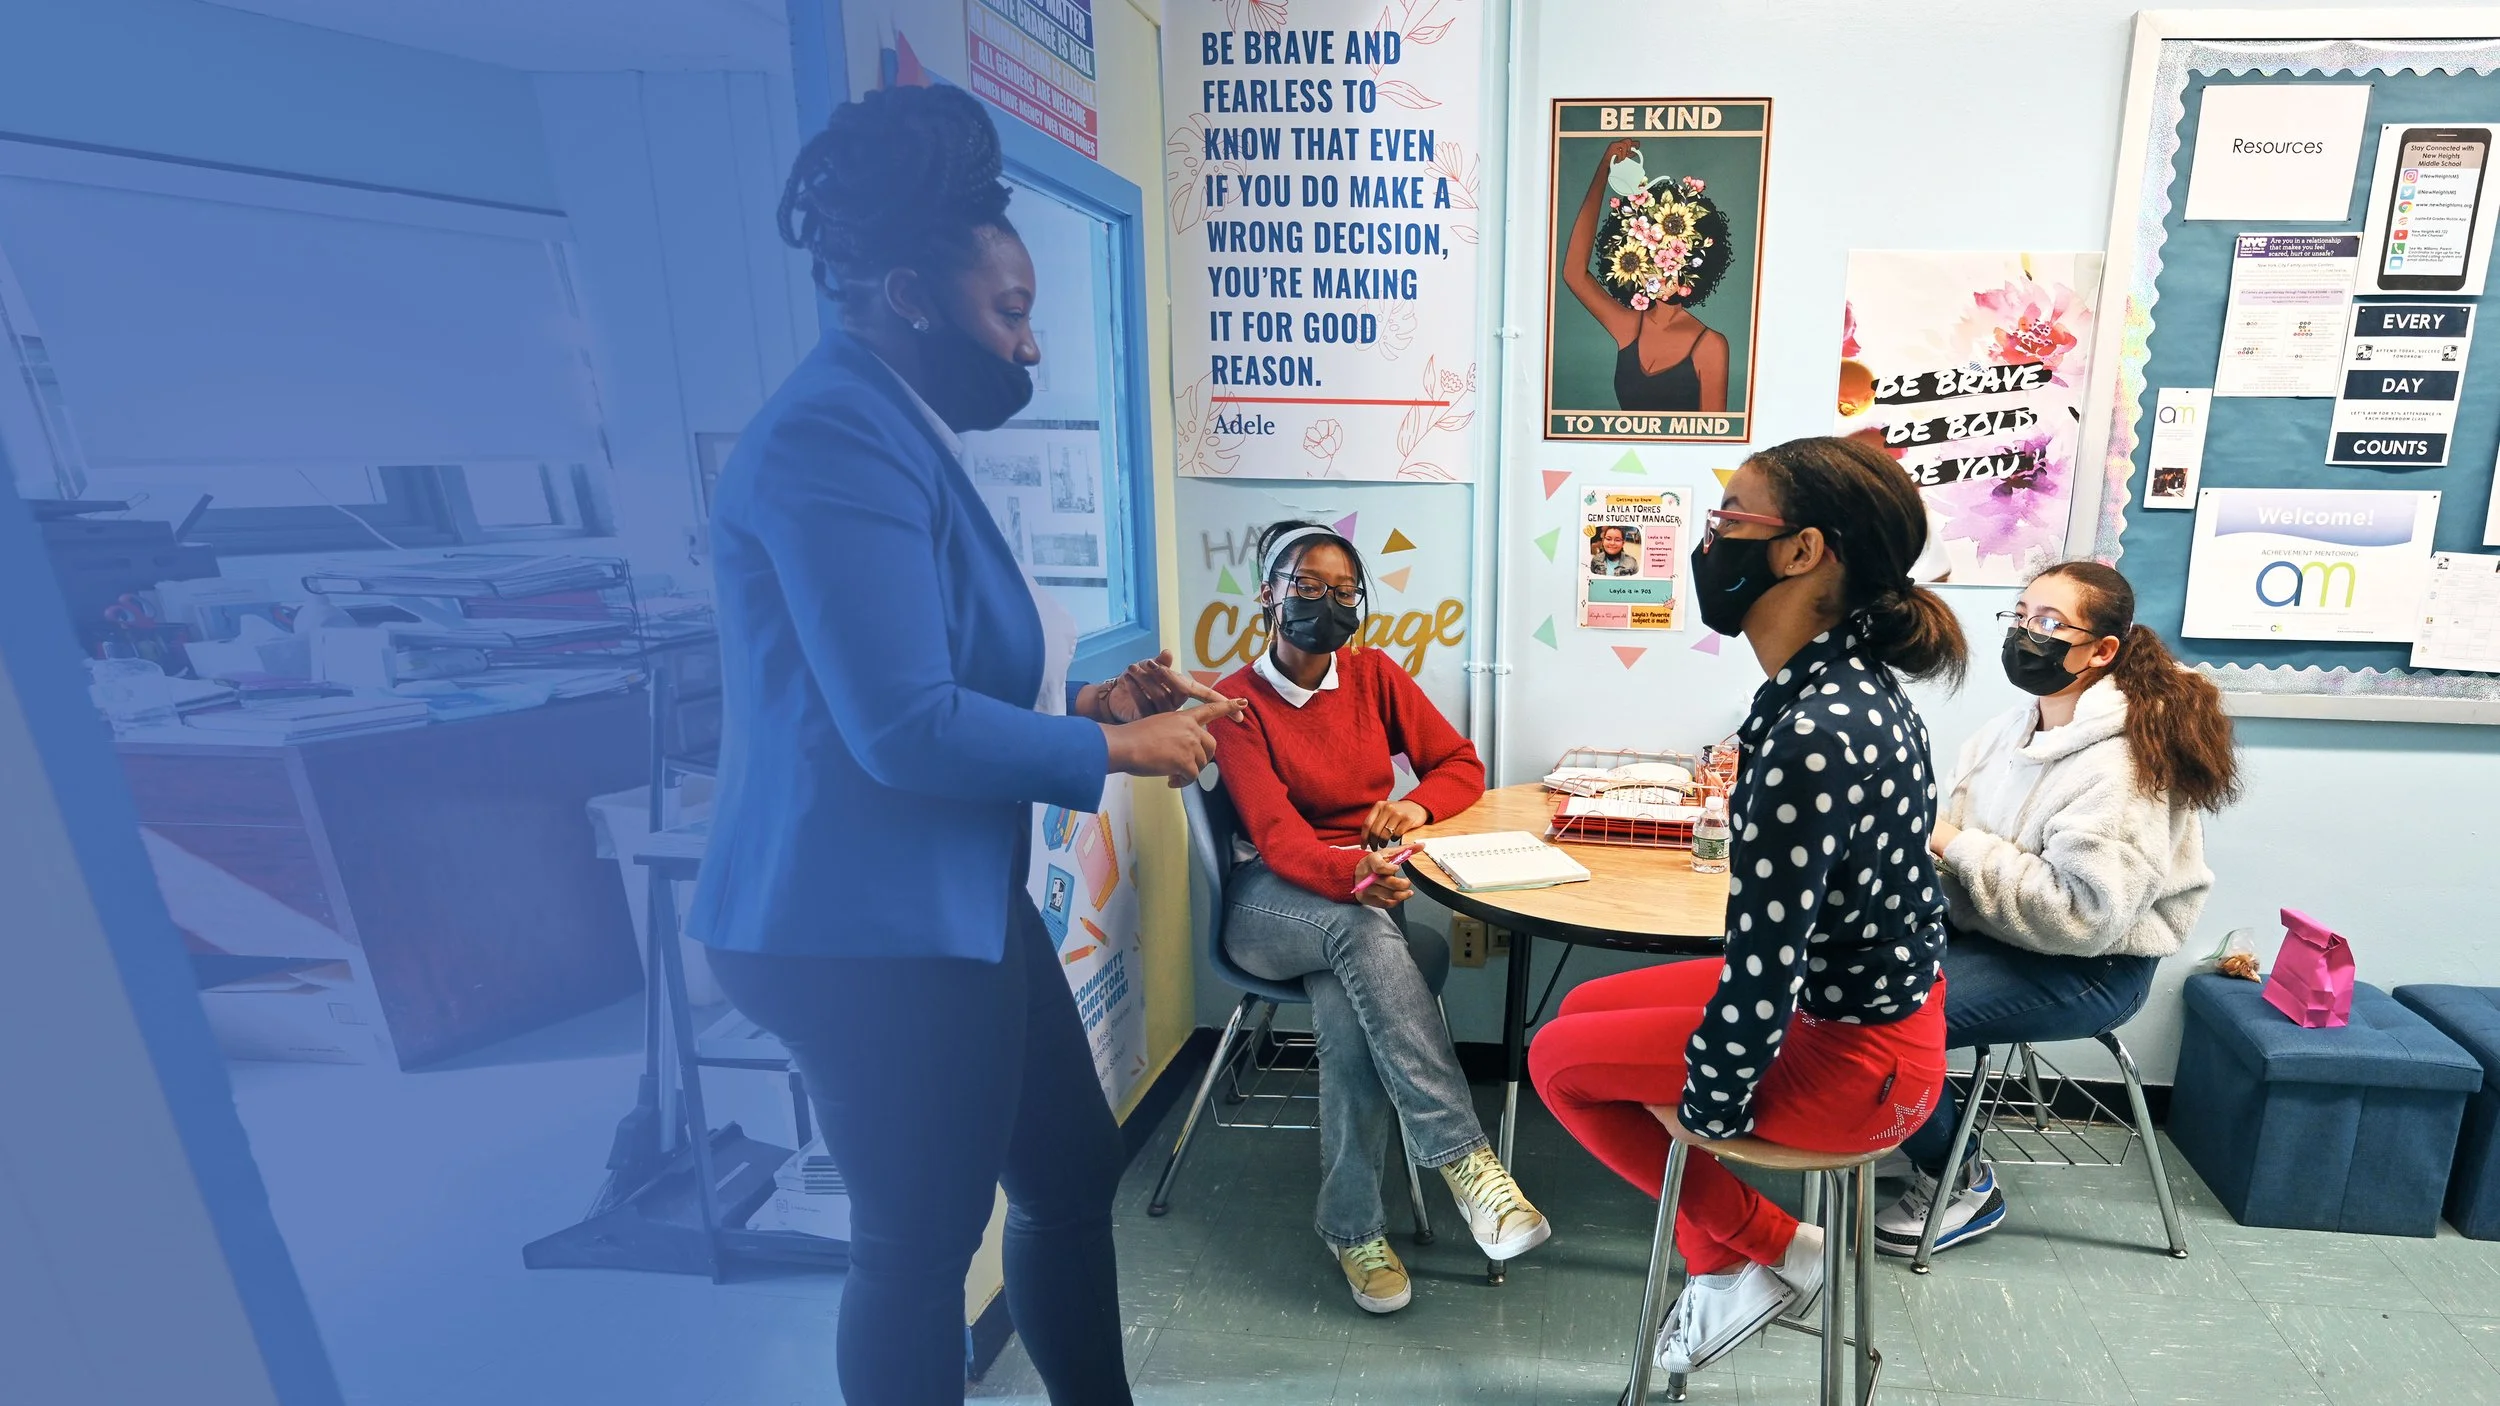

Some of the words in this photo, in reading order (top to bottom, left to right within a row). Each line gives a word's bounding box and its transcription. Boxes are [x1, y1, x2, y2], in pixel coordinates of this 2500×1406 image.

[1017, 0, 1057, 53] CHANGE
[1058, 31, 1068, 60] IS
[1070, 38, 1093, 76] REAL
[1202, 32, 1233, 65] BE
[1245, 31, 1334, 65] BRAVE
[1345, 31, 1400, 65] AND
[978, 40, 995, 71] ALL
[996, 52, 1035, 95] GENDERS
[1036, 78, 1051, 106] ARE
[1051, 87, 1087, 129] WELCOME
[1204, 80, 1333, 113] FEARLESS
[1343, 80, 1376, 113] TO
[972, 70, 1000, 102] WOMEN
[1000, 87, 1019, 112] HAVE
[1019, 99, 1044, 127] AGENCY
[1044, 113, 1058, 137] OVER
[1058, 123, 1075, 145] THEIR
[1600, 107, 1635, 130] BE
[1645, 106, 1722, 130] KIND
[1205, 127, 1280, 161] KNOW
[1292, 128, 1359, 160] THAT
[1371, 129, 1434, 162] EVEN
[2233, 138, 2323, 155] Resources
[2425, 144, 2461, 152] Connected
[1206, 175, 1234, 207] IF
[1237, 175, 1290, 207] YOU
[1303, 175, 1338, 208] DO
[1350, 176, 1423, 208] MAKE
[1434, 177, 1450, 209] A
[1207, 221, 1302, 253] WRONG
[1315, 222, 1449, 260] DECISION,
[2240, 237, 2268, 247] NYC
[2306, 237, 2342, 245] relationship
[1208, 266, 1302, 299] YOU'RE
[1313, 268, 1417, 300] MAKING
[1210, 311, 1233, 342] IT
[1243, 311, 1294, 343] FOR
[1304, 312, 1377, 344] GOOD
[2382, 313, 2445, 330] EVERY
[1212, 355, 1322, 387] REASON.
[1874, 376, 1922, 400] BE
[1934, 363, 2044, 396] BRAVE
[2382, 378, 2424, 393] DAY
[1213, 414, 1275, 435] Adele
[1565, 416, 1594, 433] TO
[1600, 416, 1662, 434] YOUR
[1669, 417, 1730, 435] MIND
[1884, 421, 1933, 446] BE
[1945, 407, 2036, 441] BOLD
[2159, 406, 2195, 424] am
[2353, 440, 2428, 456] COUNTS
[1587, 514, 1604, 522] GEM
[1605, 514, 1640, 522] STUDENT
[1642, 514, 1680, 524] MANAGER
[1606, 505, 1630, 513] LAYLA
[1632, 504, 1661, 513] TORRES
[2257, 506, 2375, 526] Welcome!
[2261, 549, 2312, 557] ACHIEVEMENT
[2314, 550, 2359, 558] MENTORING
[2255, 561, 2356, 608] am
[1632, 612, 1649, 620] Layla's
[1074, 949, 1124, 1006] COMMUNITY
[1081, 966, 1125, 1020] DIRECTORS
[1105, 979, 1129, 1013] WEEK!
